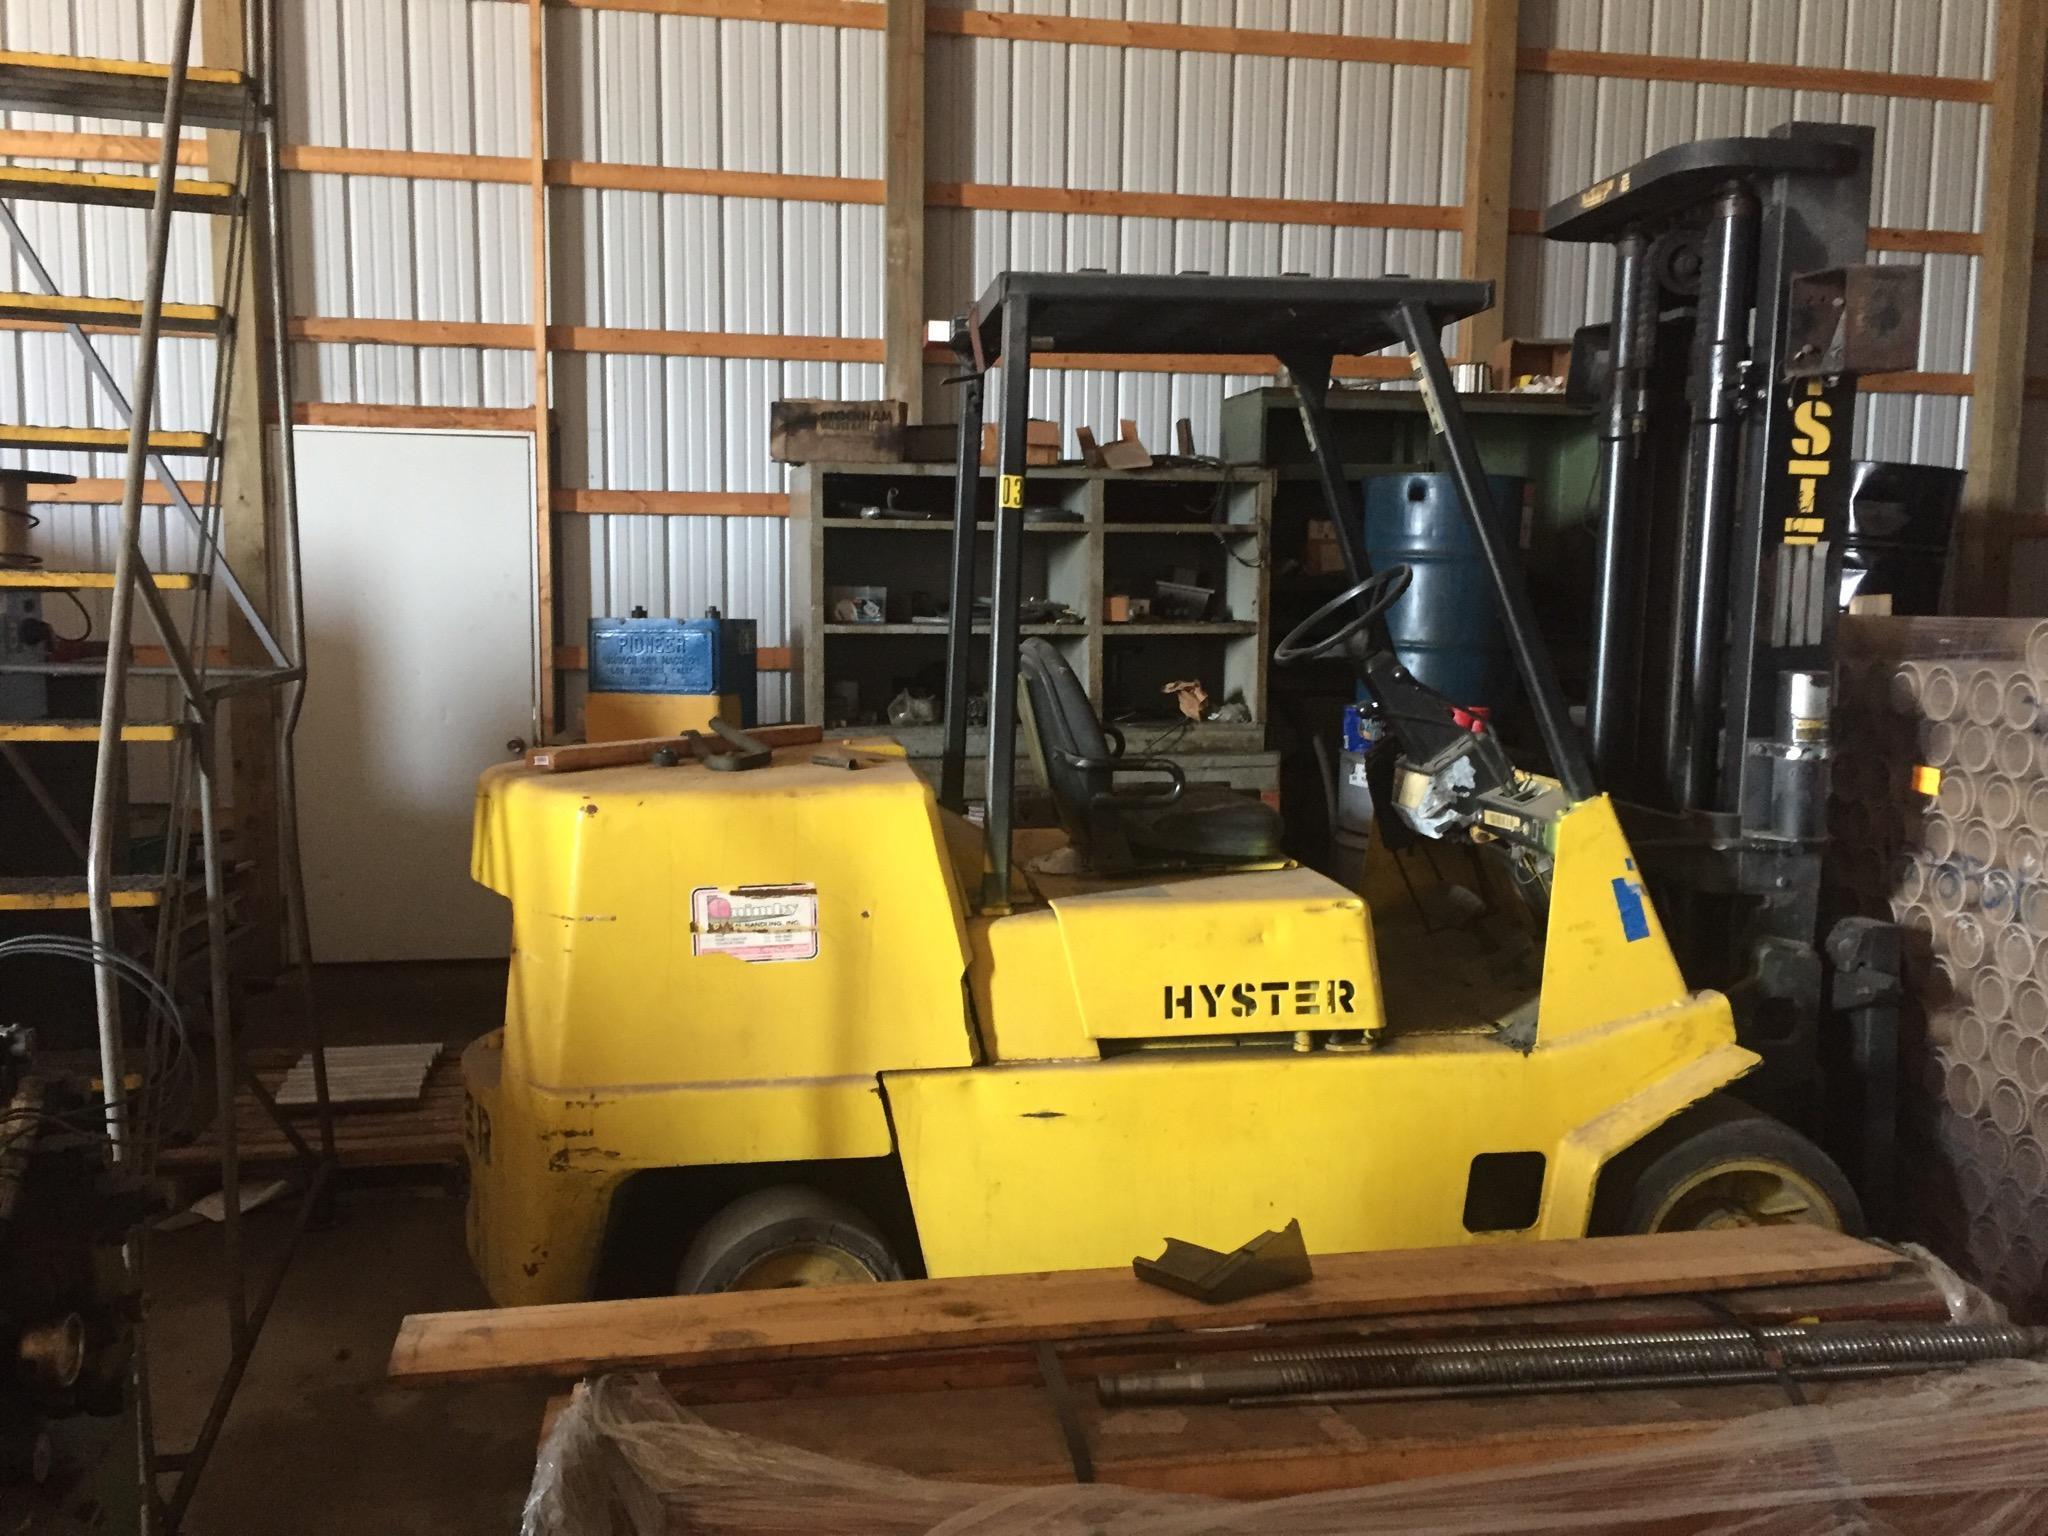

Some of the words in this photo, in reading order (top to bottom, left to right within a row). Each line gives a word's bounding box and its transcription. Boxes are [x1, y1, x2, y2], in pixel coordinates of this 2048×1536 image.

[1003, 477, 1024, 506] 03
[618, 636, 687, 654] PIONEER
[1164, 980, 1355, 1020] HYSTER
